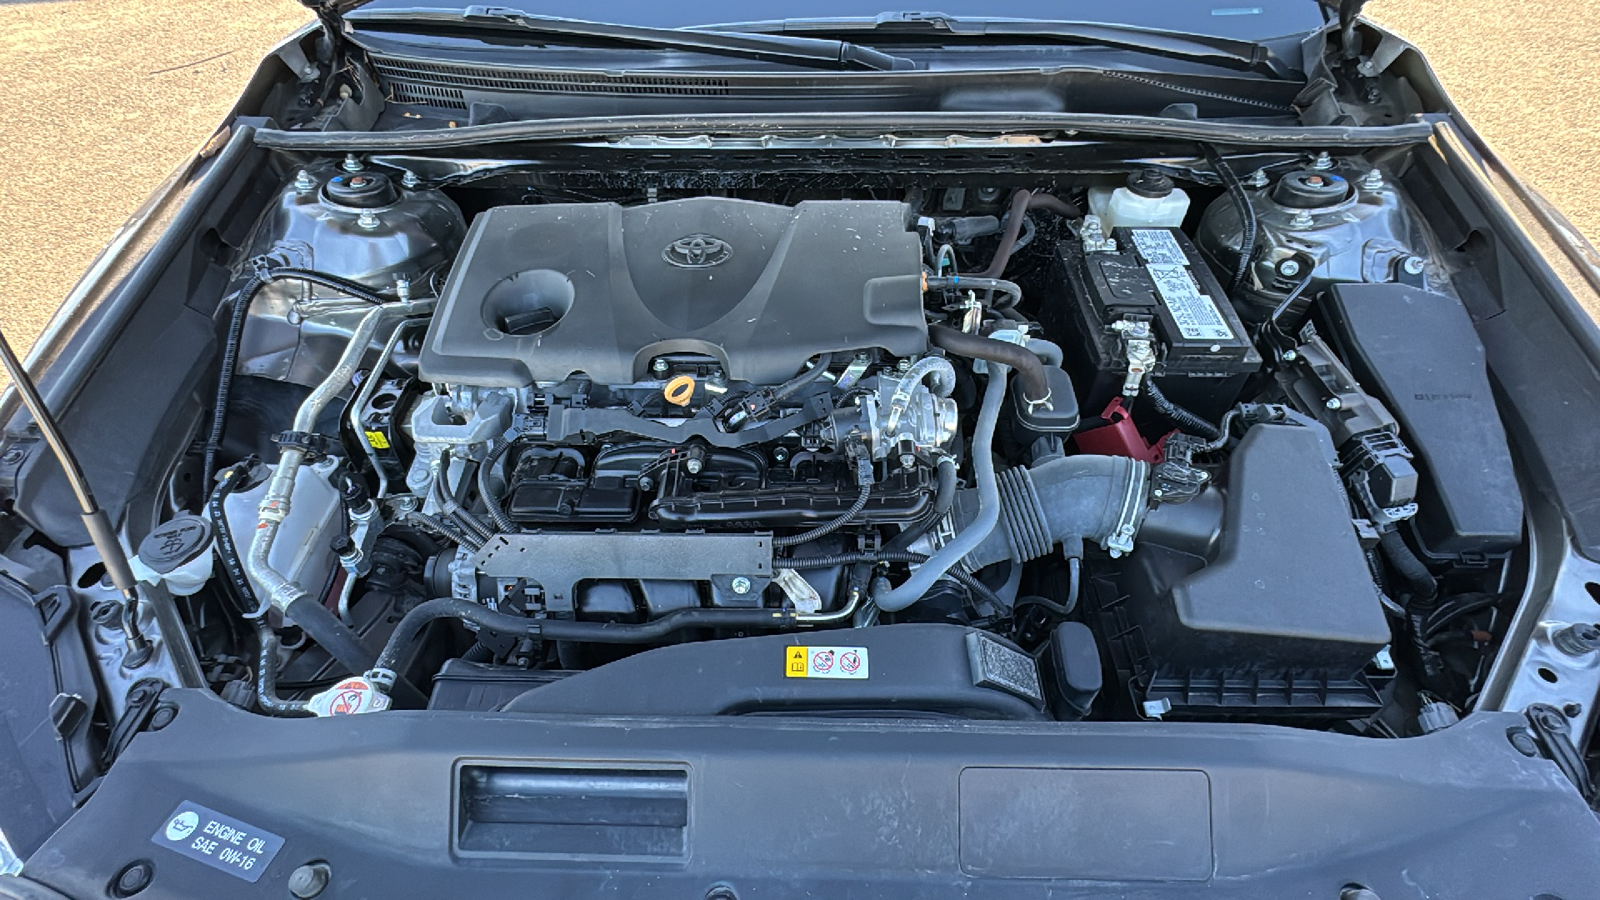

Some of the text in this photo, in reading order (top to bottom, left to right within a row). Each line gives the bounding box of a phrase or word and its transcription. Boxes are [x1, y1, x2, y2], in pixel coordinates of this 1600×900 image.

[191, 836, 256, 870] SAE 0W-16
[203, 820, 267, 854] ENGINE OIL
